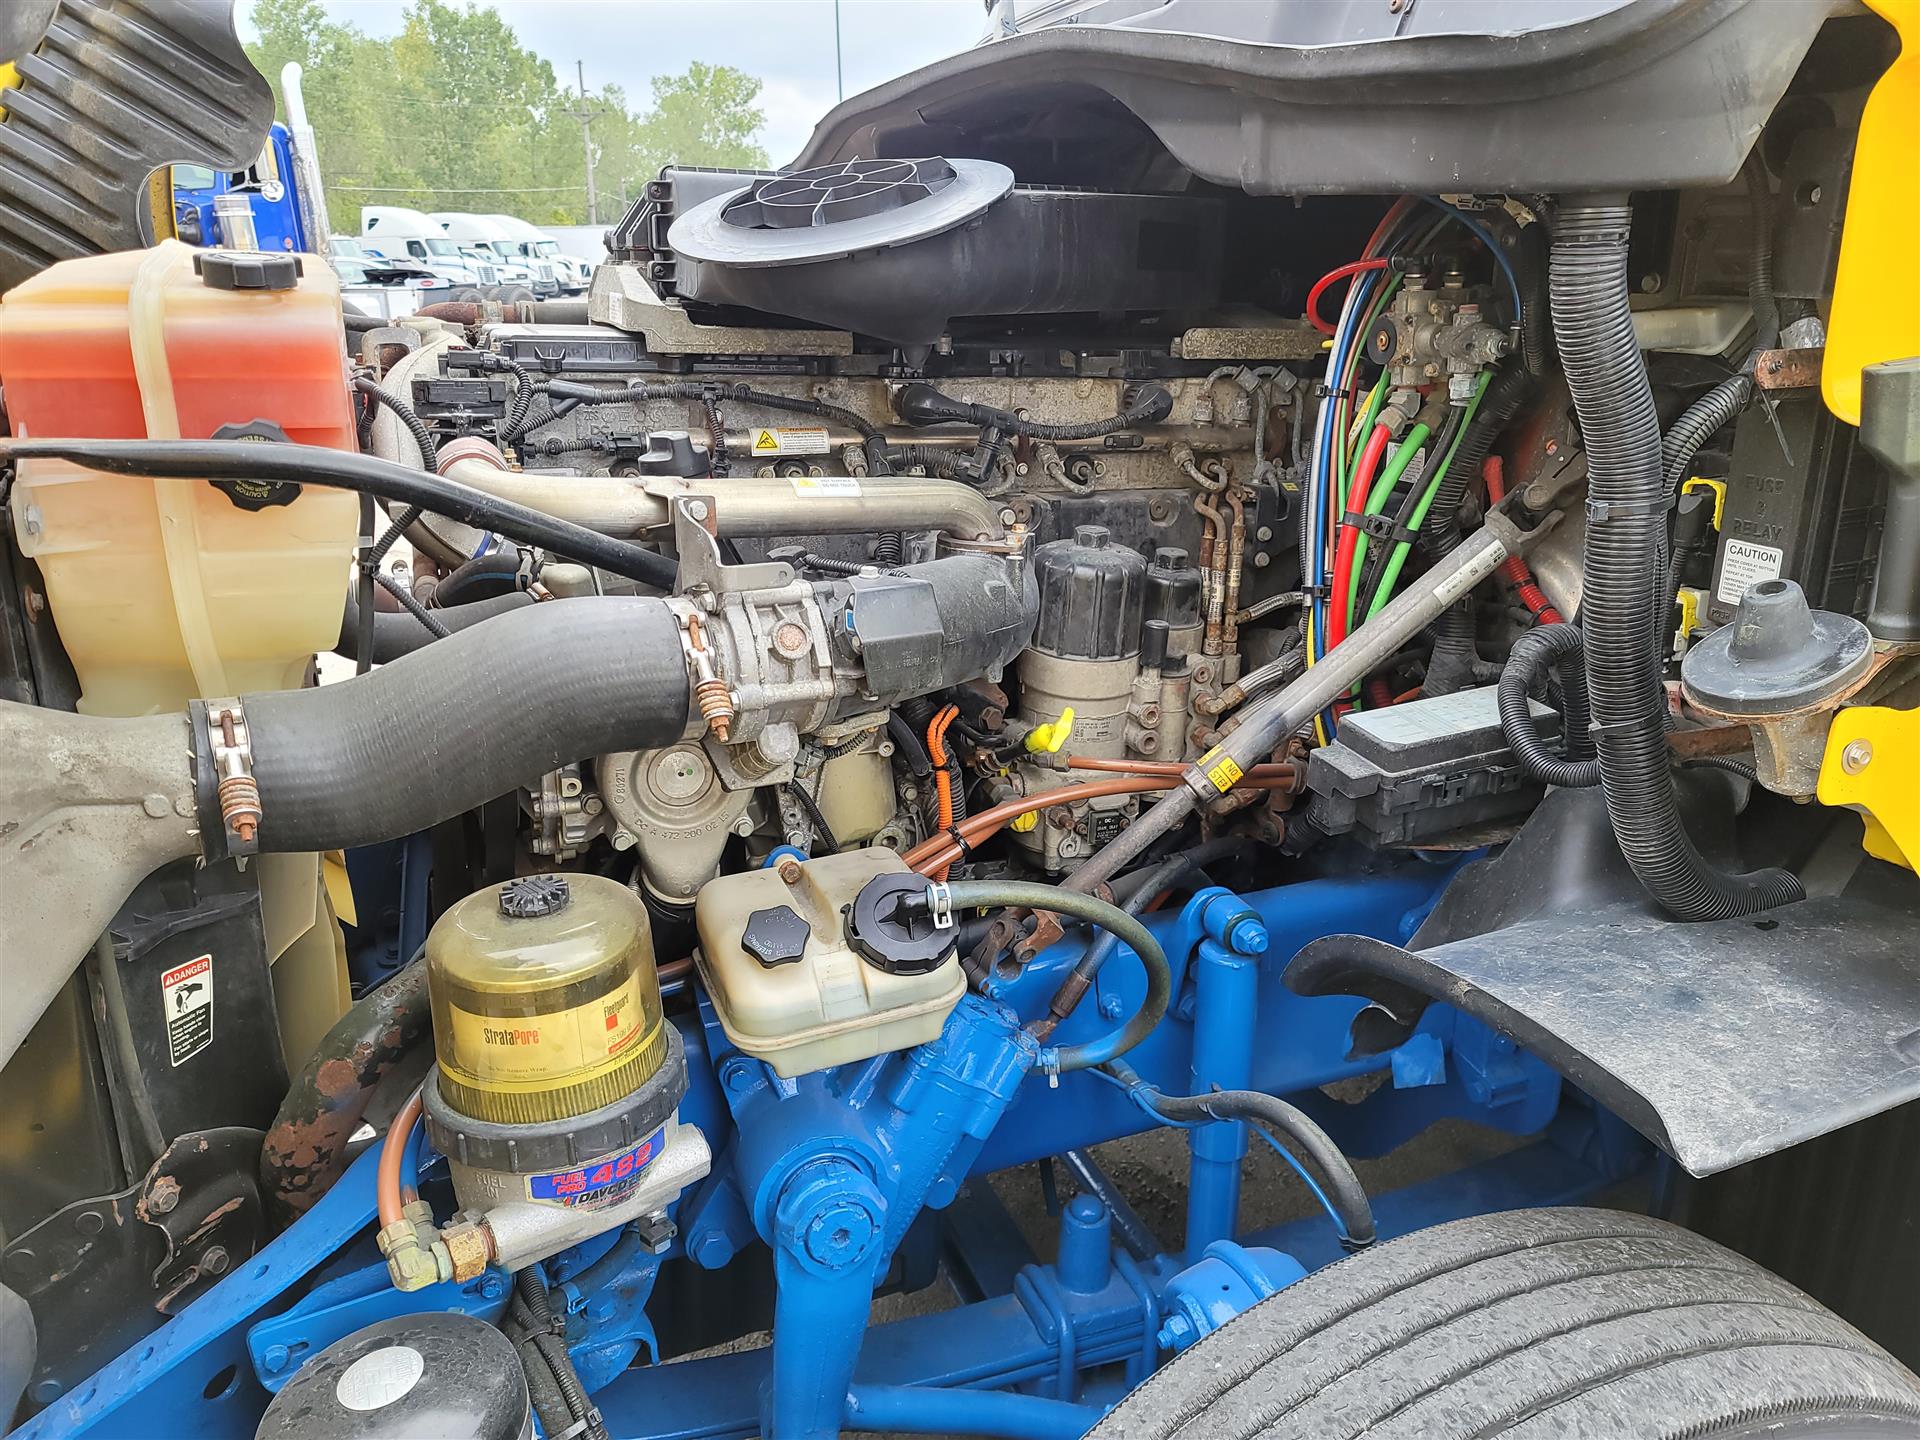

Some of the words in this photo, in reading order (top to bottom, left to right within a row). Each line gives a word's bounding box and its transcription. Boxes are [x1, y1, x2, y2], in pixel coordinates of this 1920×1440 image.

[234, 484, 262, 498] CAUTION
[1733, 517, 1784, 543] RELAY
[1729, 545, 1777, 564] CAUTION
[1210, 770, 1228, 788] STEP
[1225, 763, 1239, 777] NO
[748, 934, 773, 956] STEERING
[173, 961, 209, 982] DANGER
[604, 993, 630, 1018] Fleetguard
[483, 1027, 540, 1046] StrataPore
[590, 1142, 653, 1186] 482
[477, 1170, 507, 1189] FUEL
[552, 1170, 588, 1186] FUEL
[486, 1185, 501, 1200] IN
[556, 1181, 586, 1195] PRO
[578, 1178, 629, 1204] DAVCO
